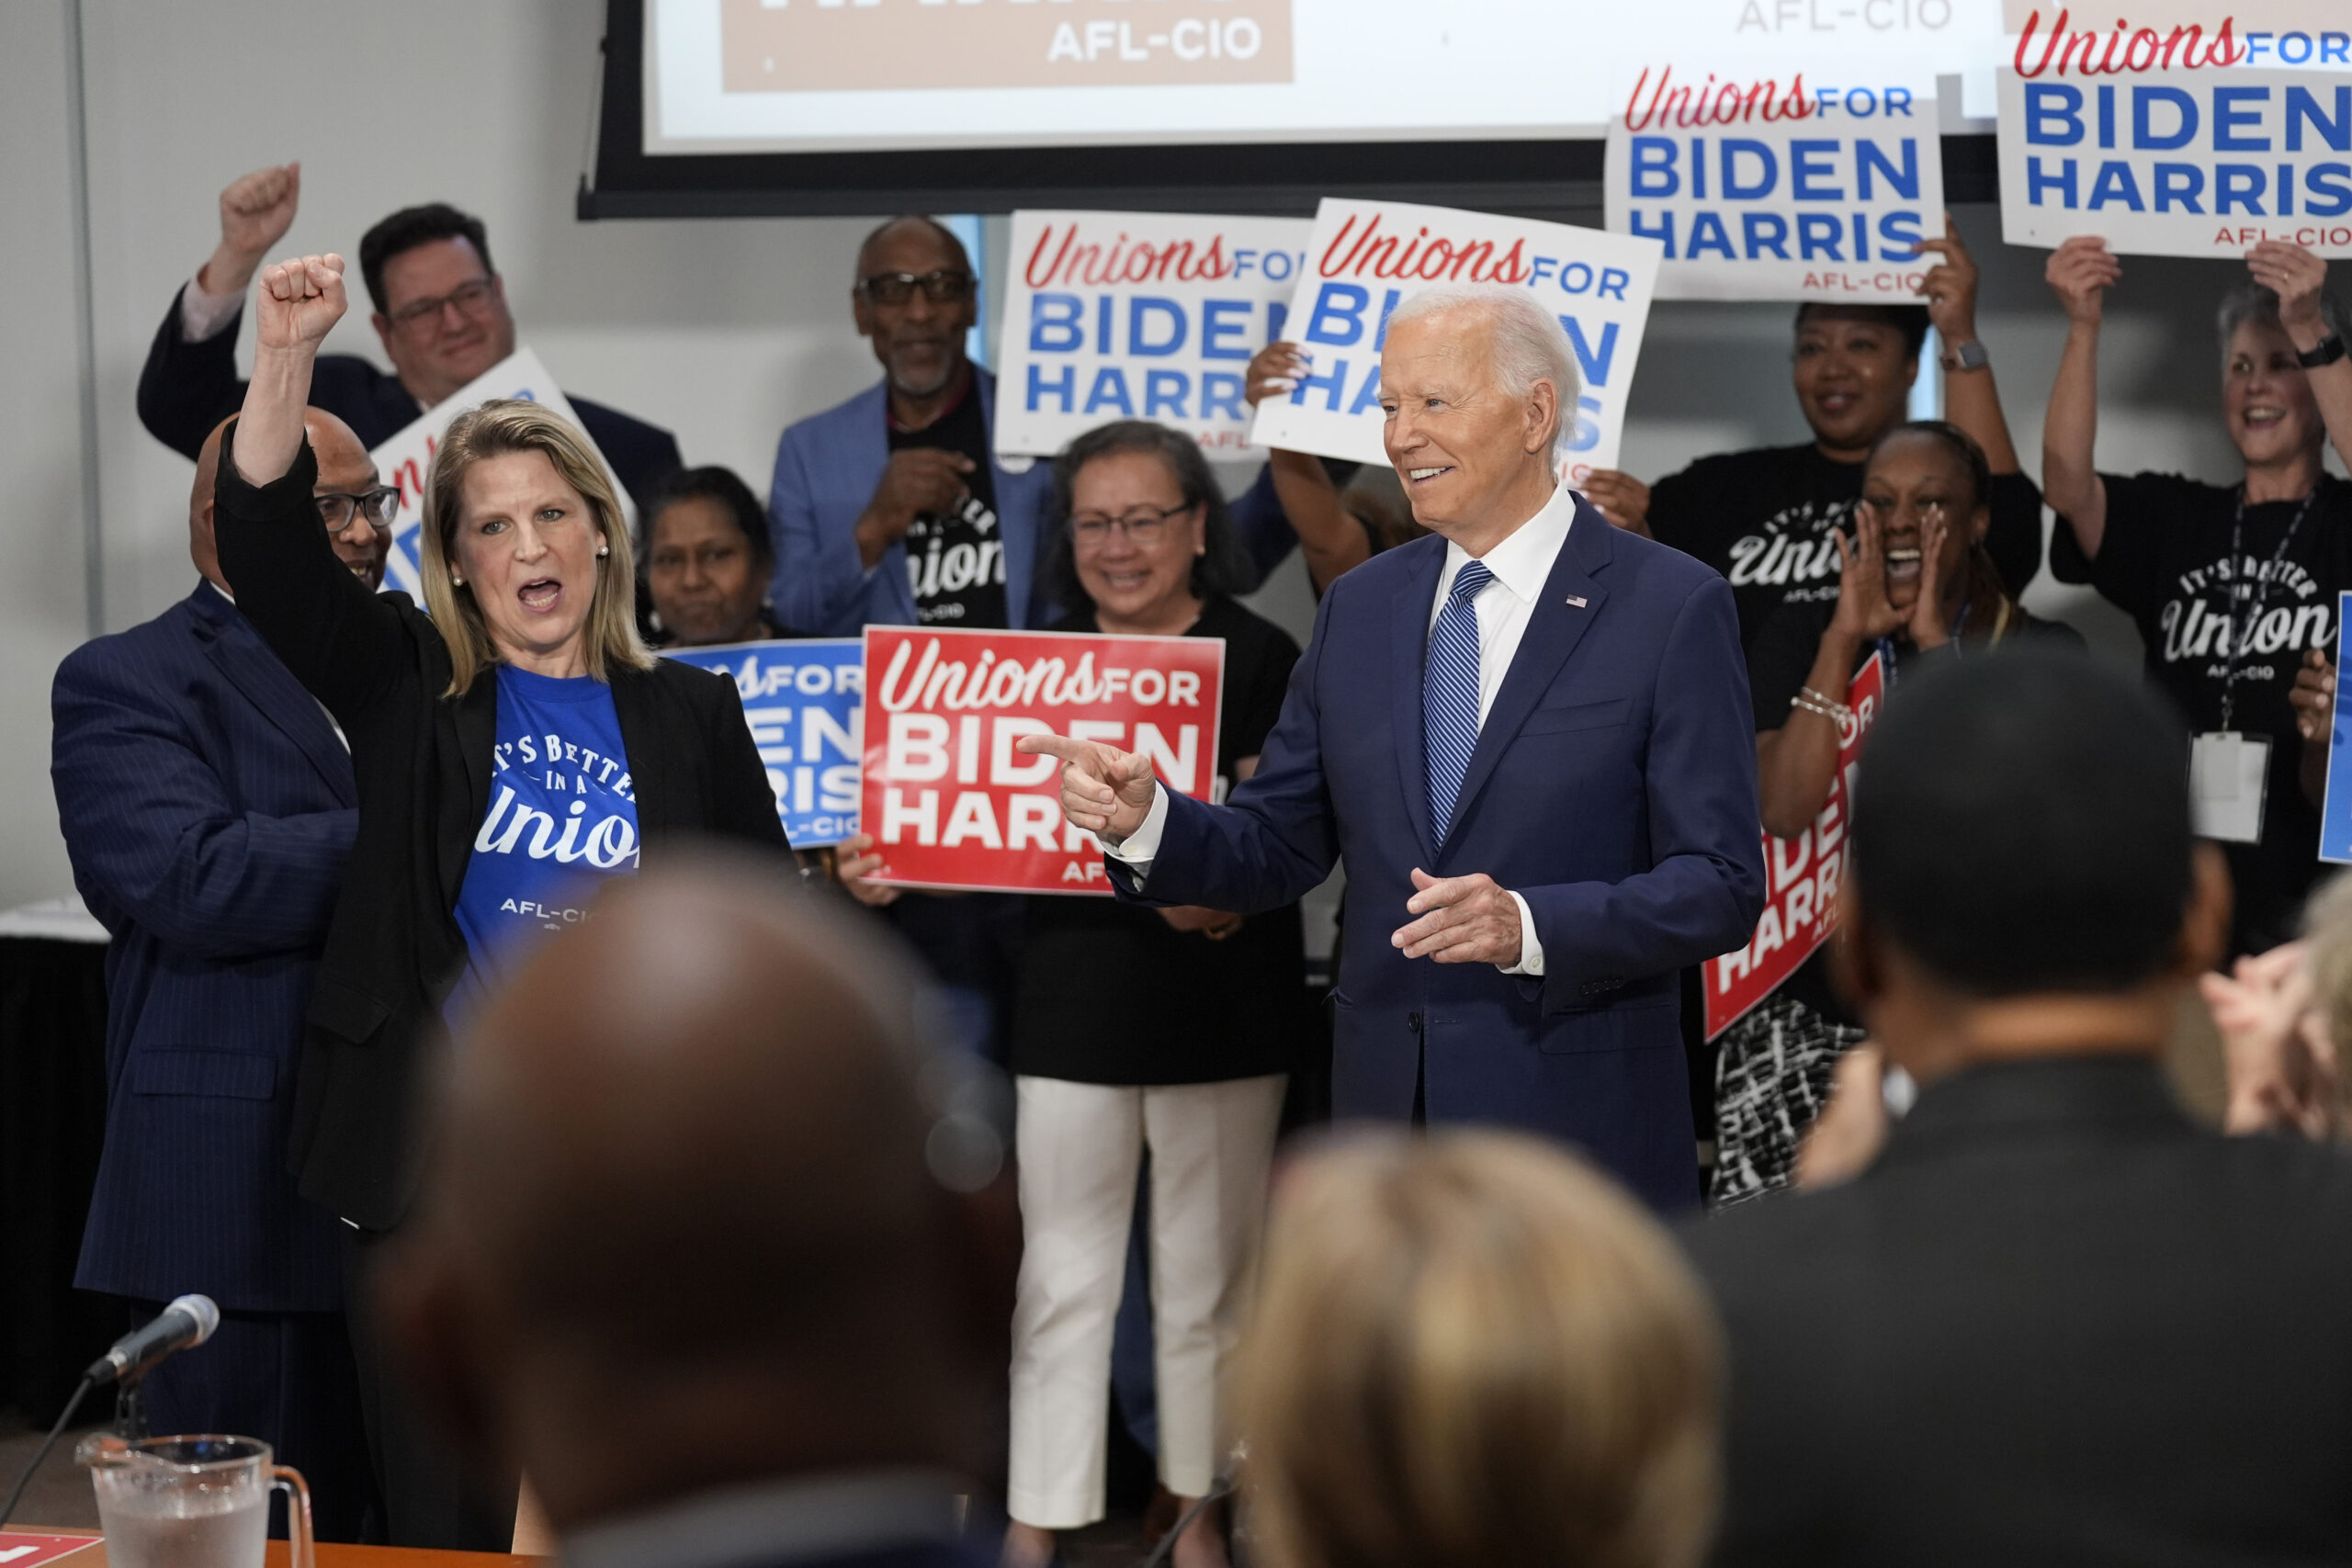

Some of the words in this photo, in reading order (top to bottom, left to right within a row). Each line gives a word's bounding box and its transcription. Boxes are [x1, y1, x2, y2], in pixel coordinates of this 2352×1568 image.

[1046, 17, 1263, 62] AFL-CIO
[1735, 0, 1952, 33] AFL-CIO
[2014, 8, 2246, 78] Unions
[2245, 31, 2351, 64] FOR
[1624, 64, 1816, 132] Unions
[1815, 87, 1914, 118] FOR
[2024, 82, 2352, 152] BIDEN
[1630, 136, 1920, 201] BIDEN
[2027, 155, 2352, 217] HARRIS
[1025, 223, 1234, 289] Unions
[1234, 249, 1306, 281] FO
[1319, 214, 1532, 284] Unions
[1529, 255, 1630, 301] FOR
[1630, 209, 1923, 263] HARRIS
[1305, 282, 1620, 388] BIN
[1025, 364, 1246, 421] HARR
[1728, 535, 1859, 586] Uni
[2161, 599, 2338, 662] Union
[766, 663, 864, 696] FOR
[879, 638, 1103, 713] Unions
[1102, 669, 1201, 706] FOR
[492, 735, 537, 778] T'S
[545, 734, 637, 805] BETTE
[547, 771, 567, 790] IN
[577, 774, 587, 795] A
[474, 785, 640, 869] nio
[881, 790, 1105, 854] HAR
[500, 897, 587, 923] AFL-CI
